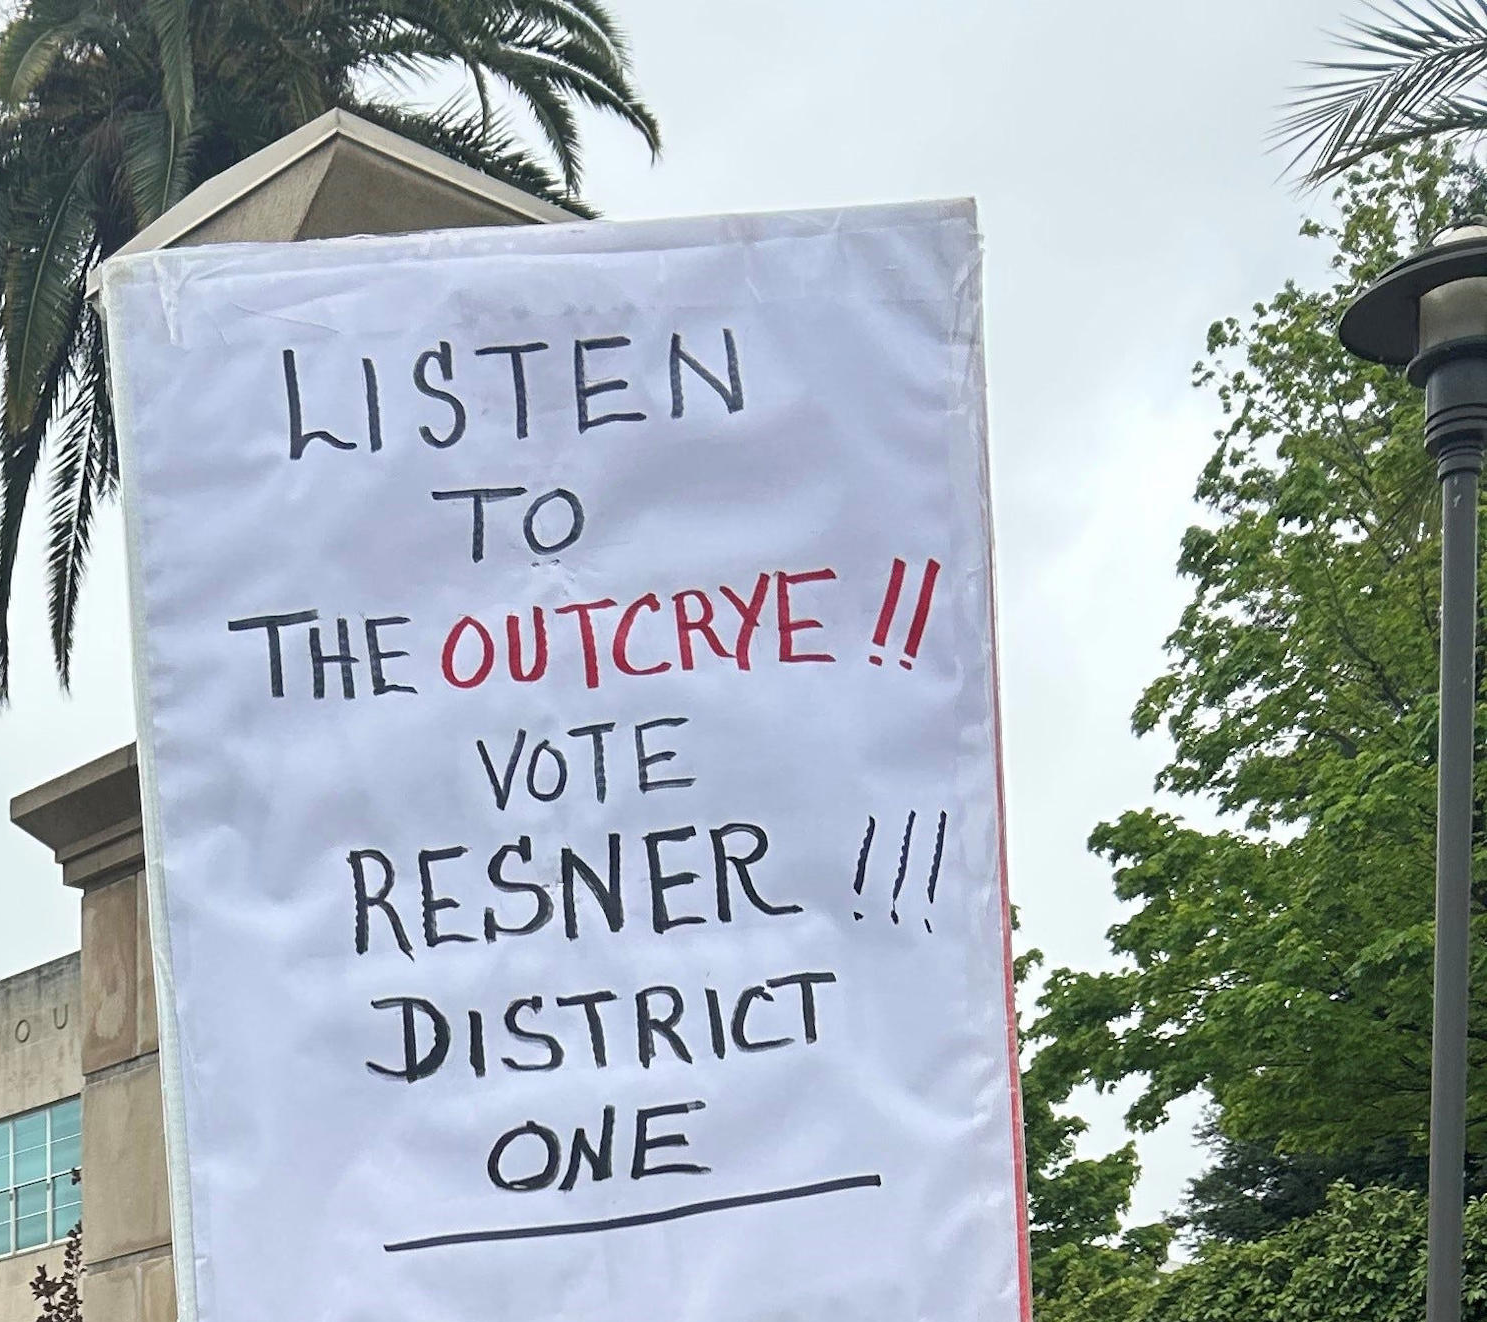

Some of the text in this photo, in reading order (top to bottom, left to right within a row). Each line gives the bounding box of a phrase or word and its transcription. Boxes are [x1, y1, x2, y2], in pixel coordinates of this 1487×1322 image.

[282, 328, 744, 460] LISTEN
[432, 486, 586, 563] TO
[228, 610, 418, 700] THE
[441, 567, 838, 692] OUTCRYE
[476, 717, 697, 810] VOTE
[347, 823, 802, 961] RESNER
[366, 971, 836, 1083] DISTRICT
[486, 1101, 712, 1191] ONE
